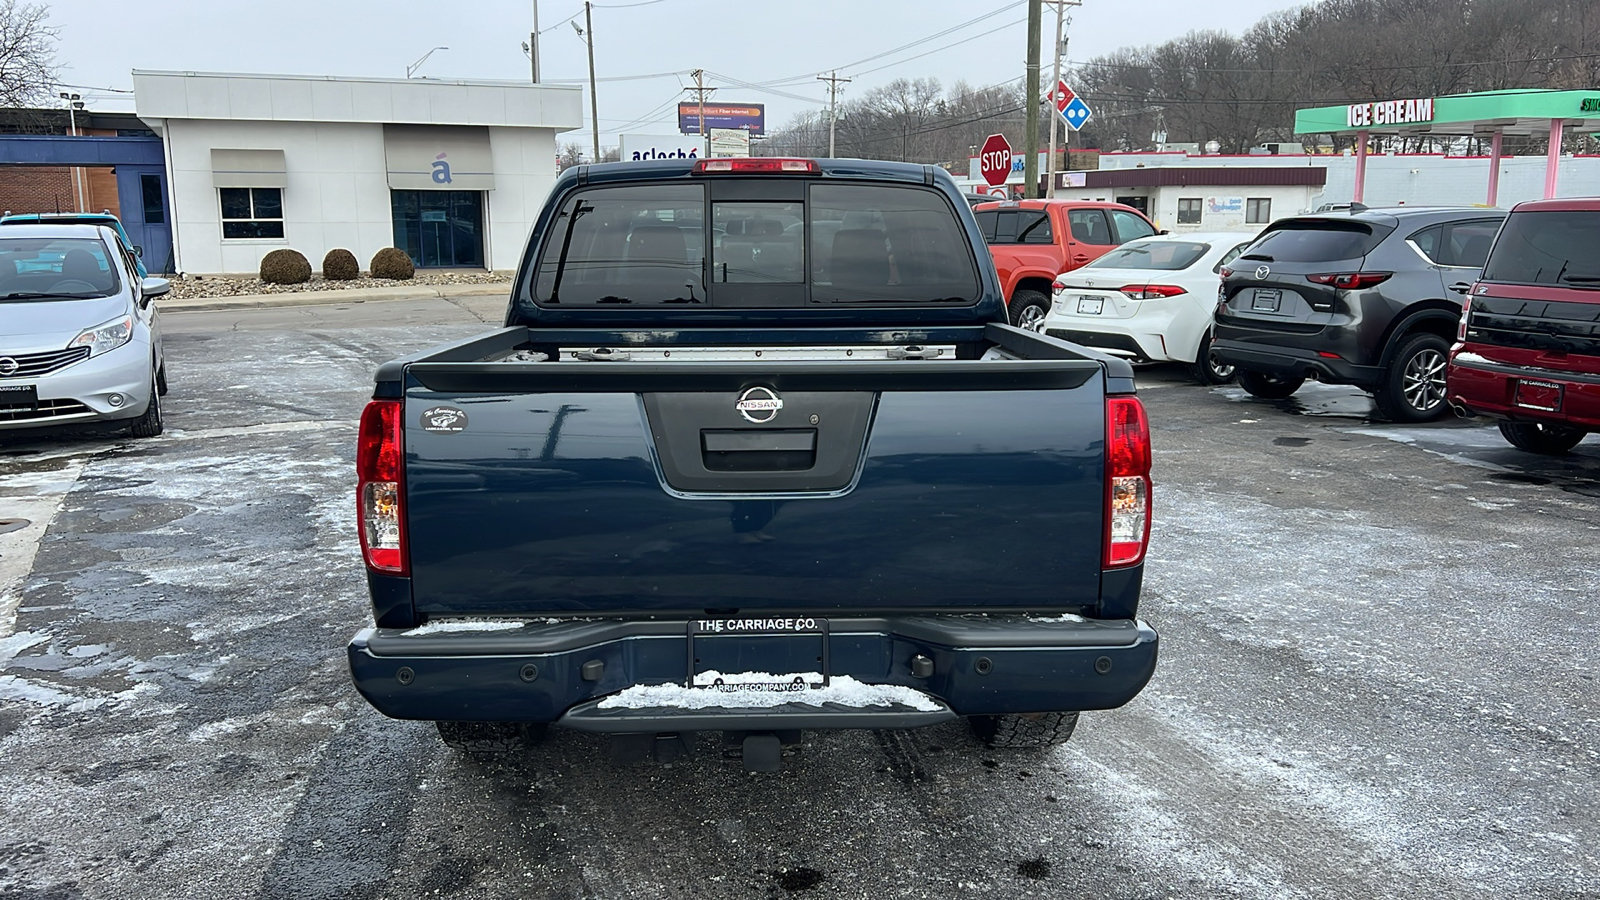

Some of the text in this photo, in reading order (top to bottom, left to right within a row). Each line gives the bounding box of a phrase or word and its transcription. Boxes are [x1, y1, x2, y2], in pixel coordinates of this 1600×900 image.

[1347, 98, 1433, 127] ICE CREAM
[982, 150, 1010, 172] STOP
[740, 401, 778, 409] NISSAN
[698, 618, 818, 631] THE CARRIAGE CO.
[706, 683, 812, 692] CARRIAGECOMPANY.COM
